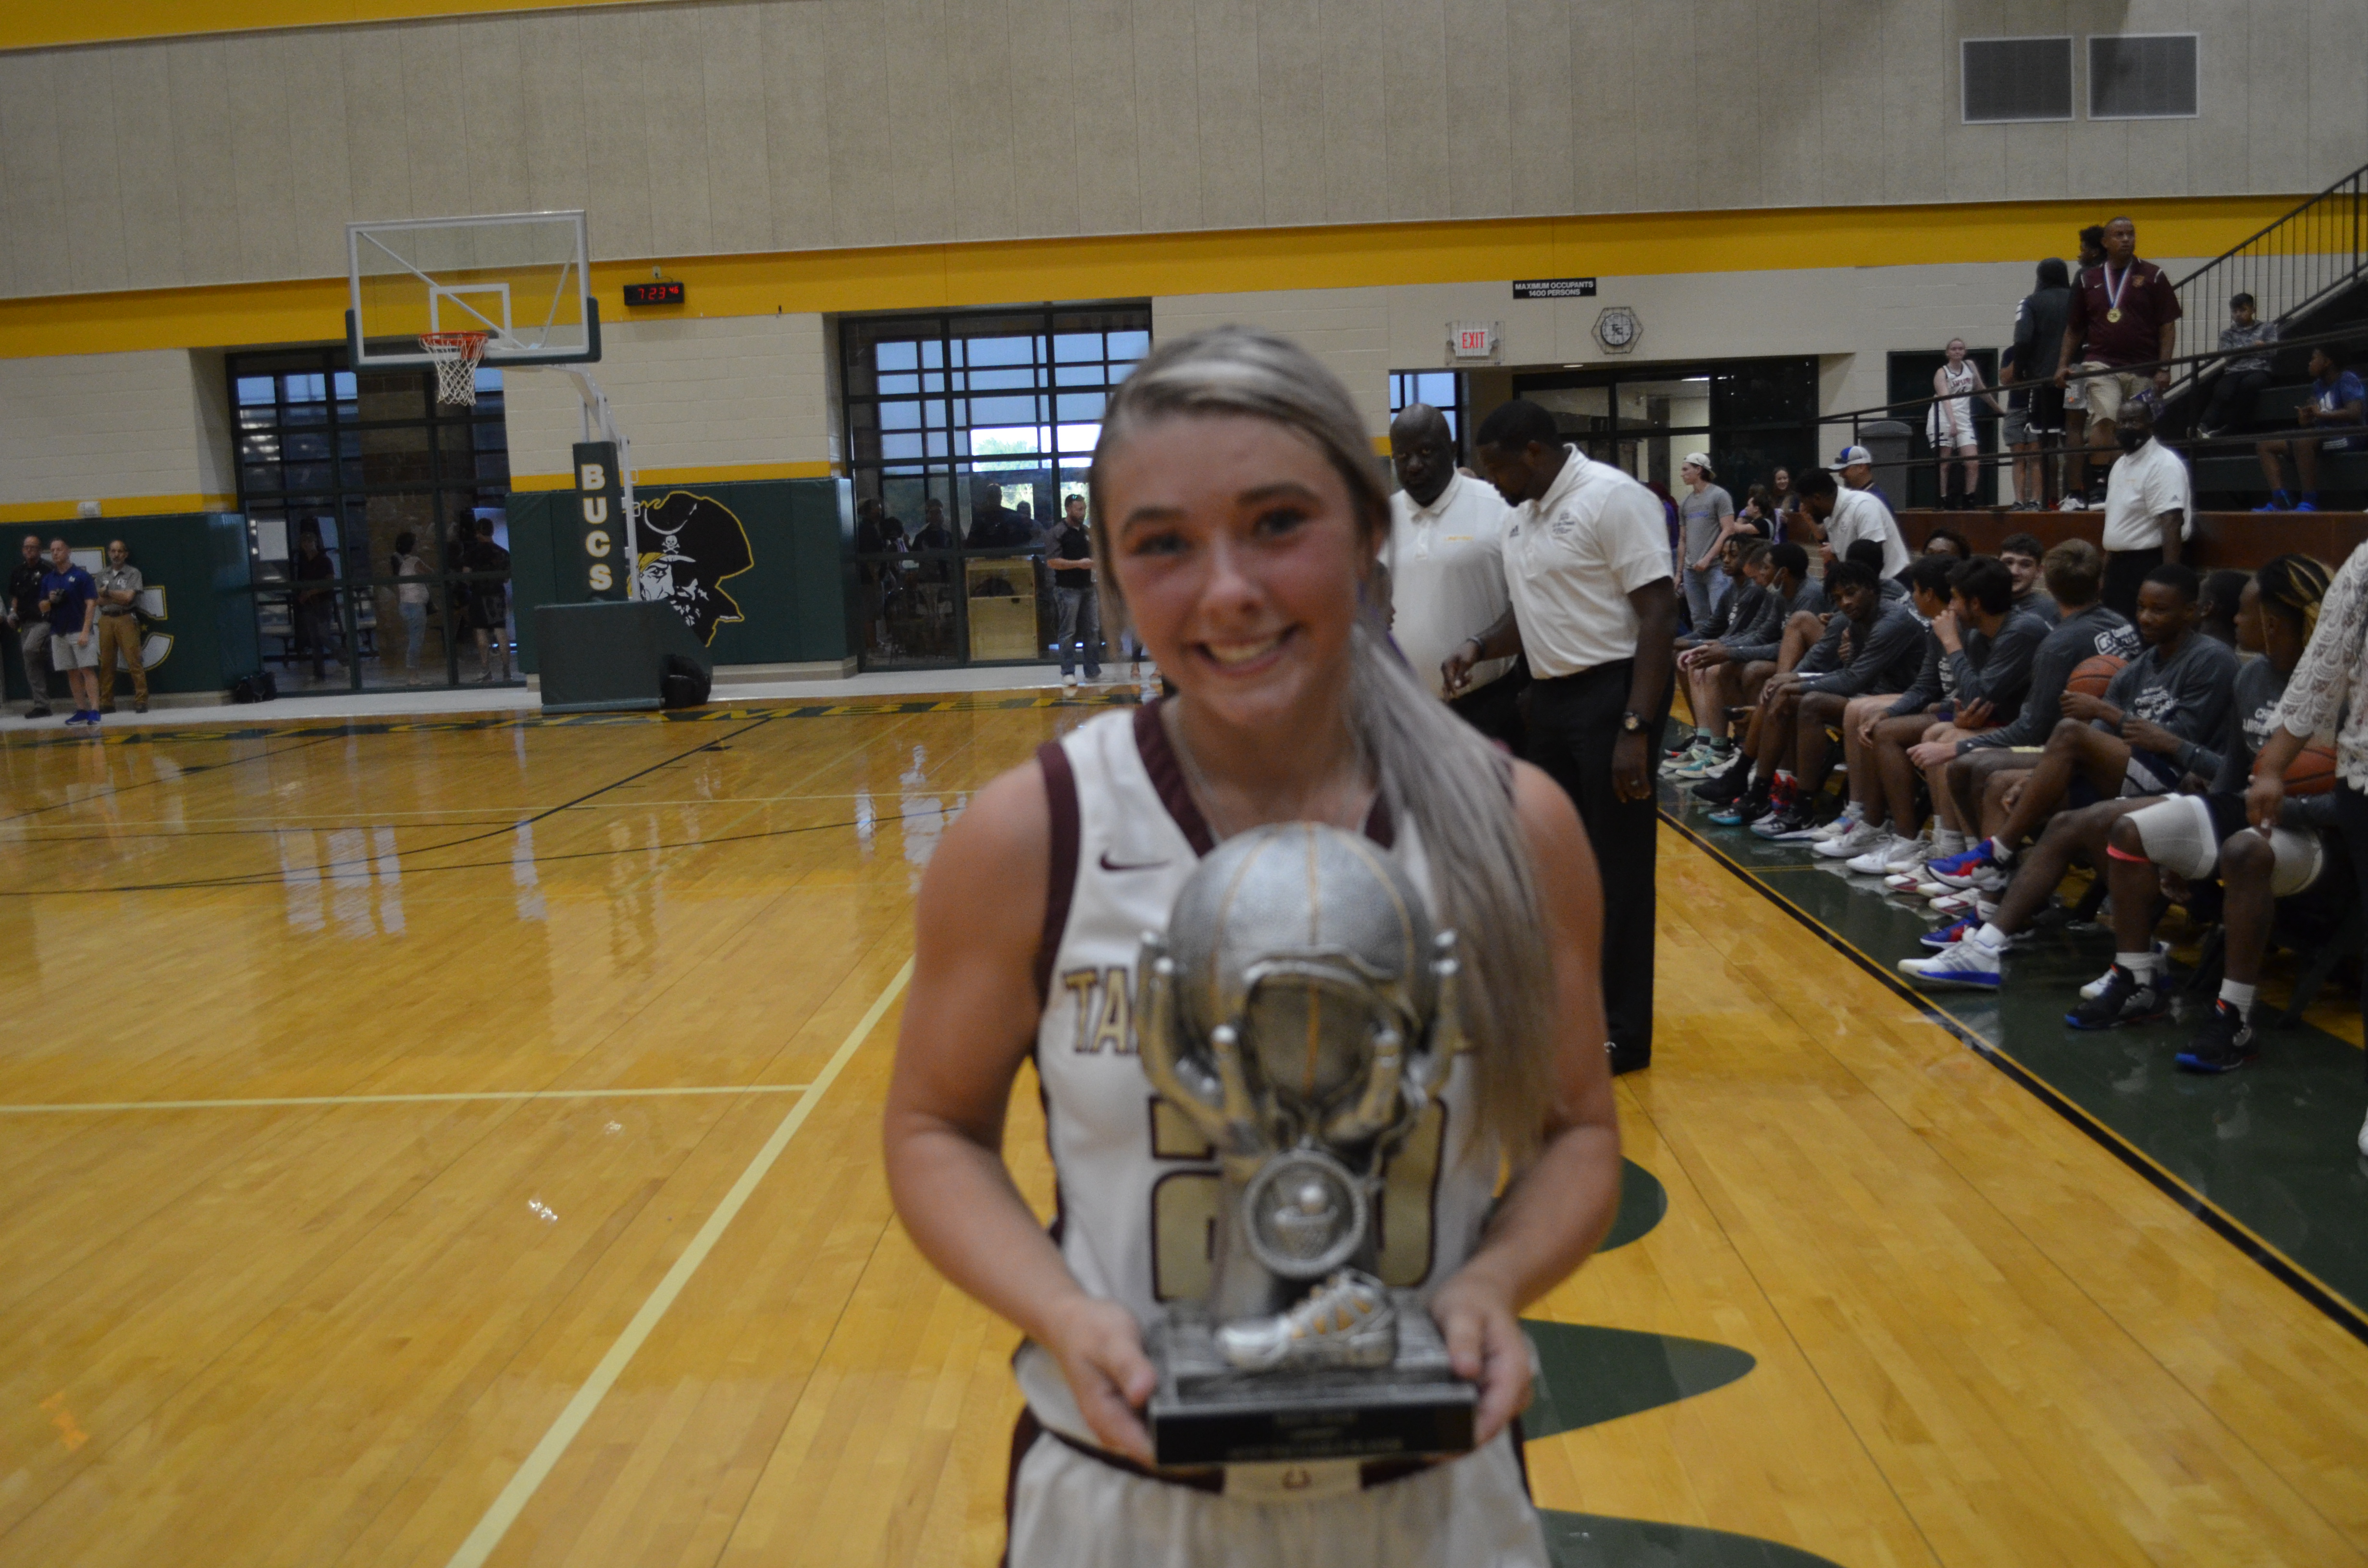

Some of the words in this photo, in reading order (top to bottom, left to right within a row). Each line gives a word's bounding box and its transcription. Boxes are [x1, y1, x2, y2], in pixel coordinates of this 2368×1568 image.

[1515, 282, 1549, 290] MAXIMUM
[1462, 331, 1485, 349] EXIT
[580, 464, 613, 591] BUCS
[1062, 966, 1140, 1055] TA
